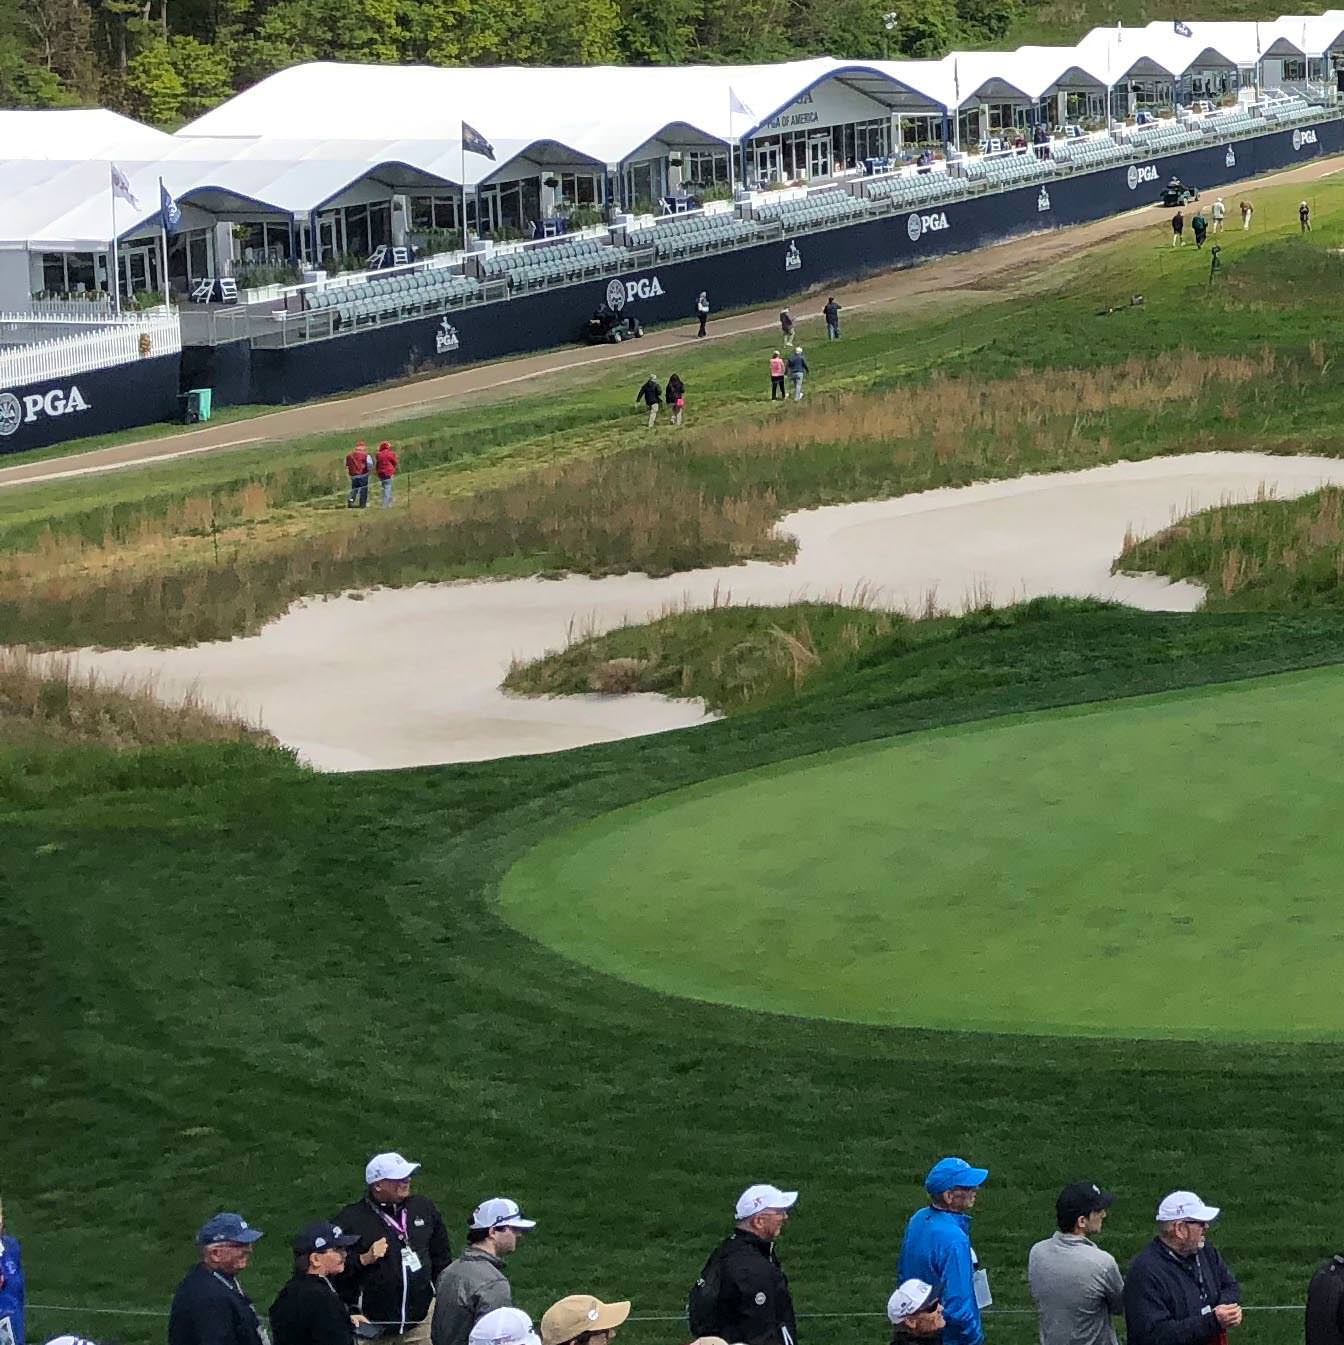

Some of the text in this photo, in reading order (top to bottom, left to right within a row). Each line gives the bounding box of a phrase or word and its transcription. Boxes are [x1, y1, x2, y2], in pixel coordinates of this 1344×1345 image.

[1301, 129, 1317, 145] PGA
[1137, 165, 1159, 183] PGA
[921, 212, 949, 233] PGA
[625, 276, 664, 303] PGA
[22, 385, 89, 423] PGA
